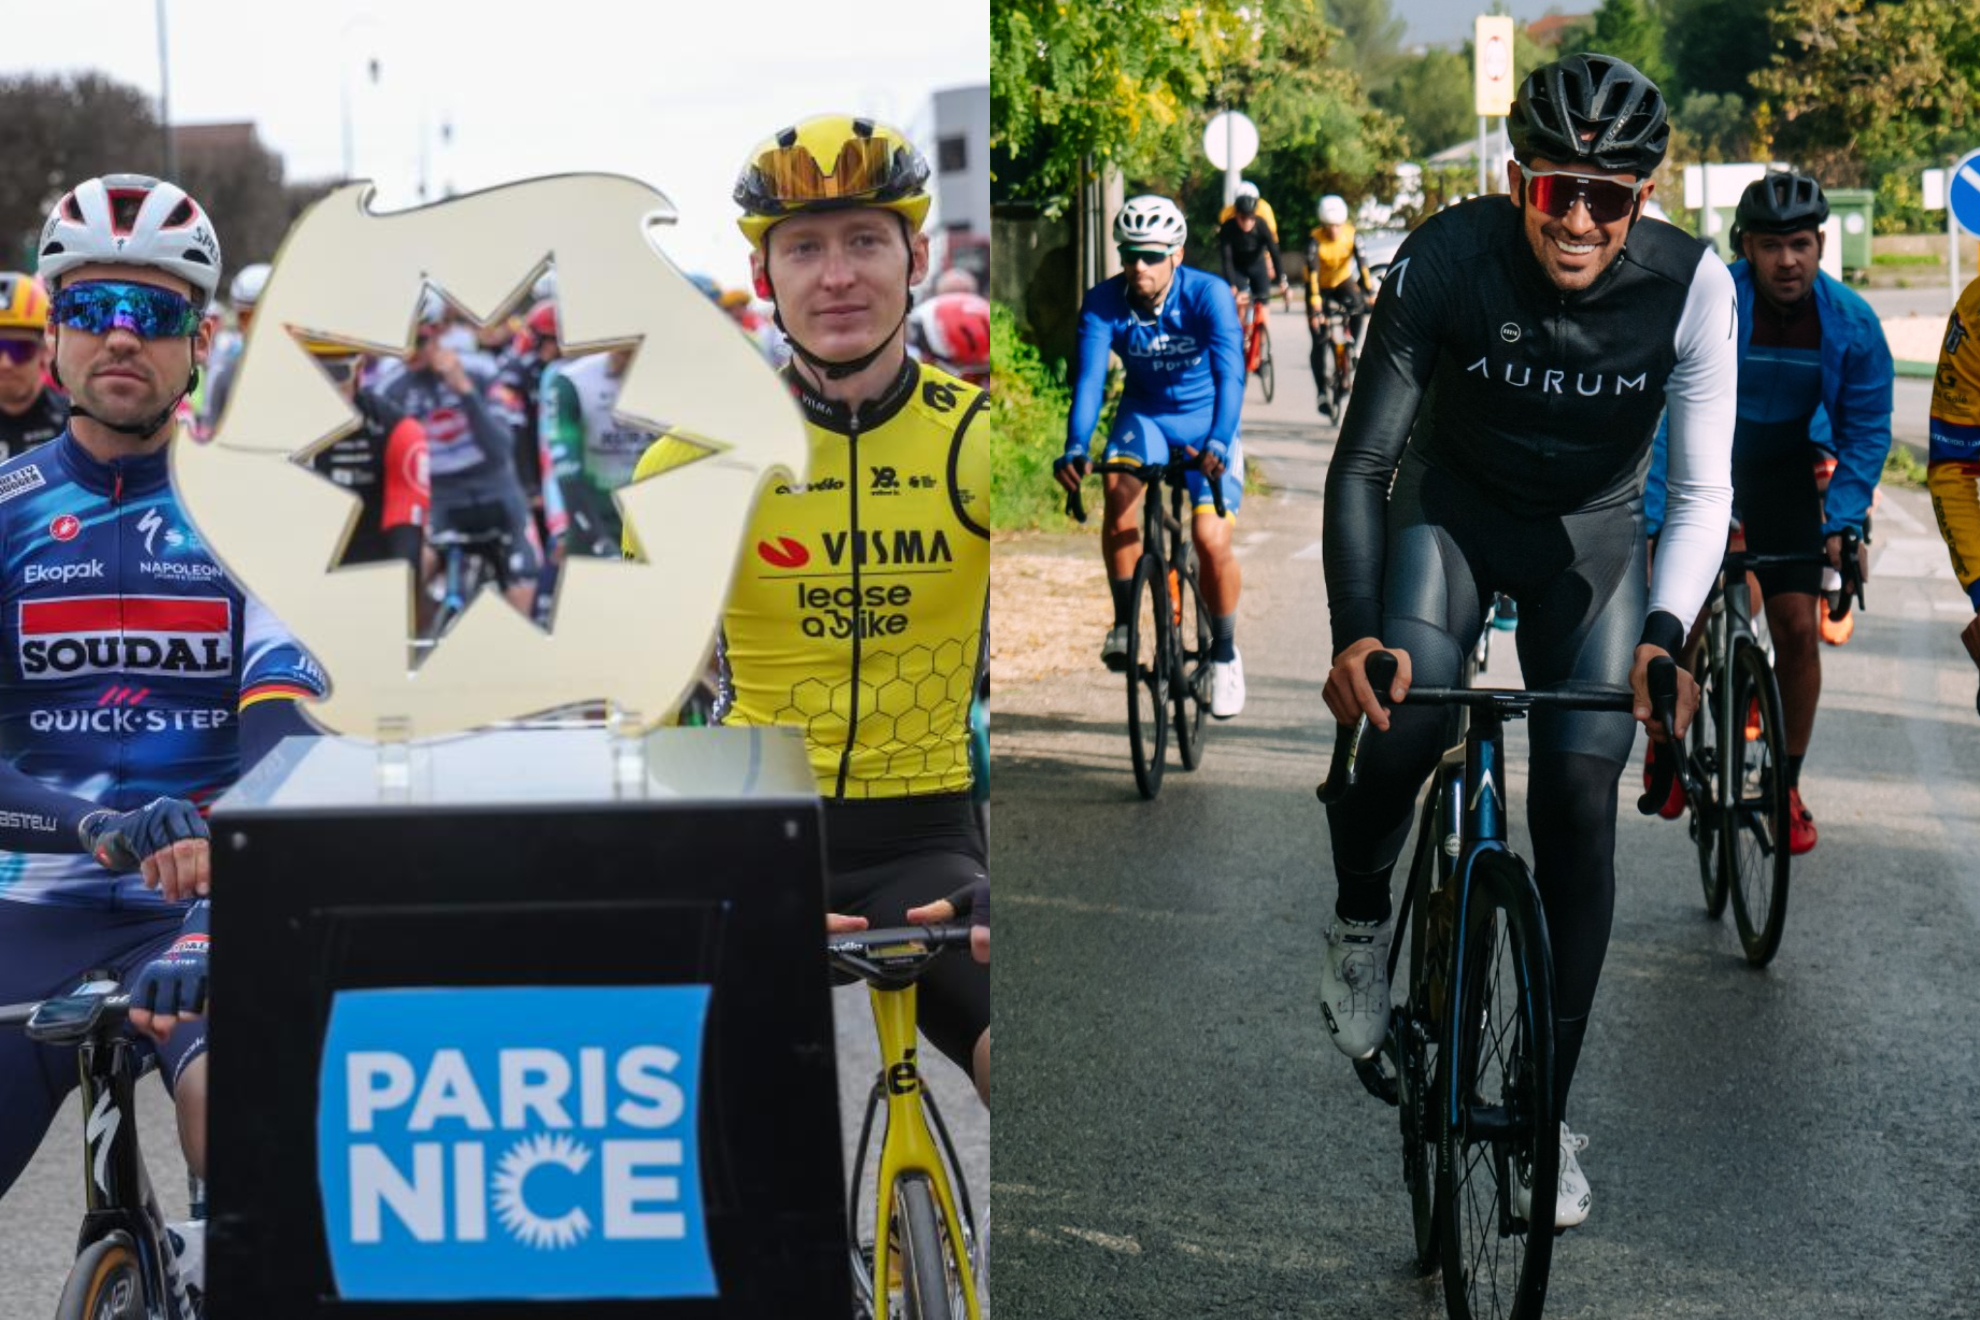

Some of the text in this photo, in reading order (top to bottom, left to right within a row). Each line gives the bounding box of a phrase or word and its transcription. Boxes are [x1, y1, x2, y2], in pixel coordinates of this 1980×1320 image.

[1467, 356, 1647, 396] AURUM
[821, 530, 953, 566] VISMA
[24, 559, 105, 583] Ekopak
[140, 561, 223, 577] NAPOLEON
[798, 582, 912, 609] lease
[22, 636, 230, 675] SOUDAL
[346, 1045, 685, 1132] PARIS
[349, 1131, 686, 1250] NICE
